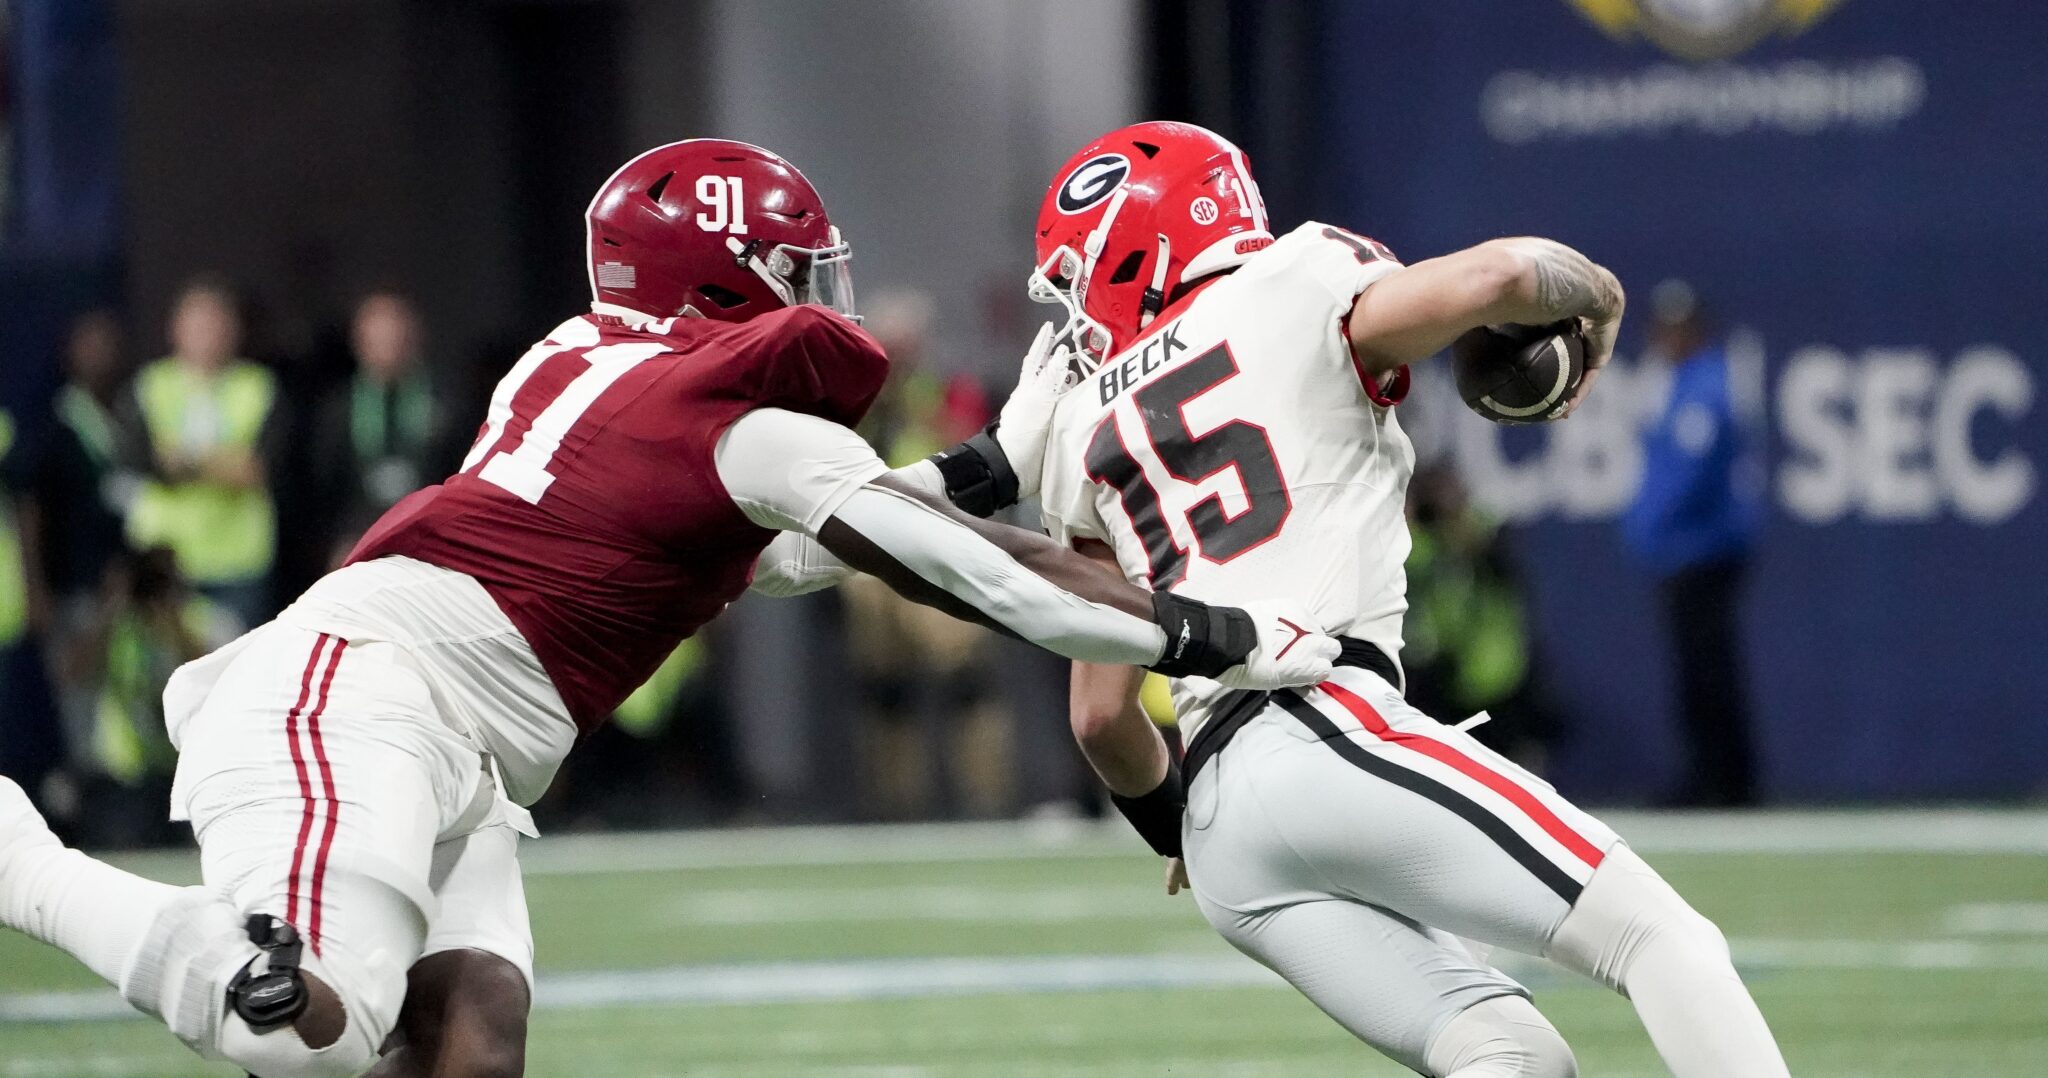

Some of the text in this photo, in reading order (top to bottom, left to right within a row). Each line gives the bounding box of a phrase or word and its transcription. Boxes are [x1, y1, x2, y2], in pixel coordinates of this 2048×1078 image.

[696, 175, 748, 234] 91
[1058, 155, 1128, 212] G
[1193, 200, 1216, 222] SEC
[1101, 319, 1188, 407] BECK
[1084, 339, 1292, 592] 15
[1778, 346, 2034, 523] SEC
